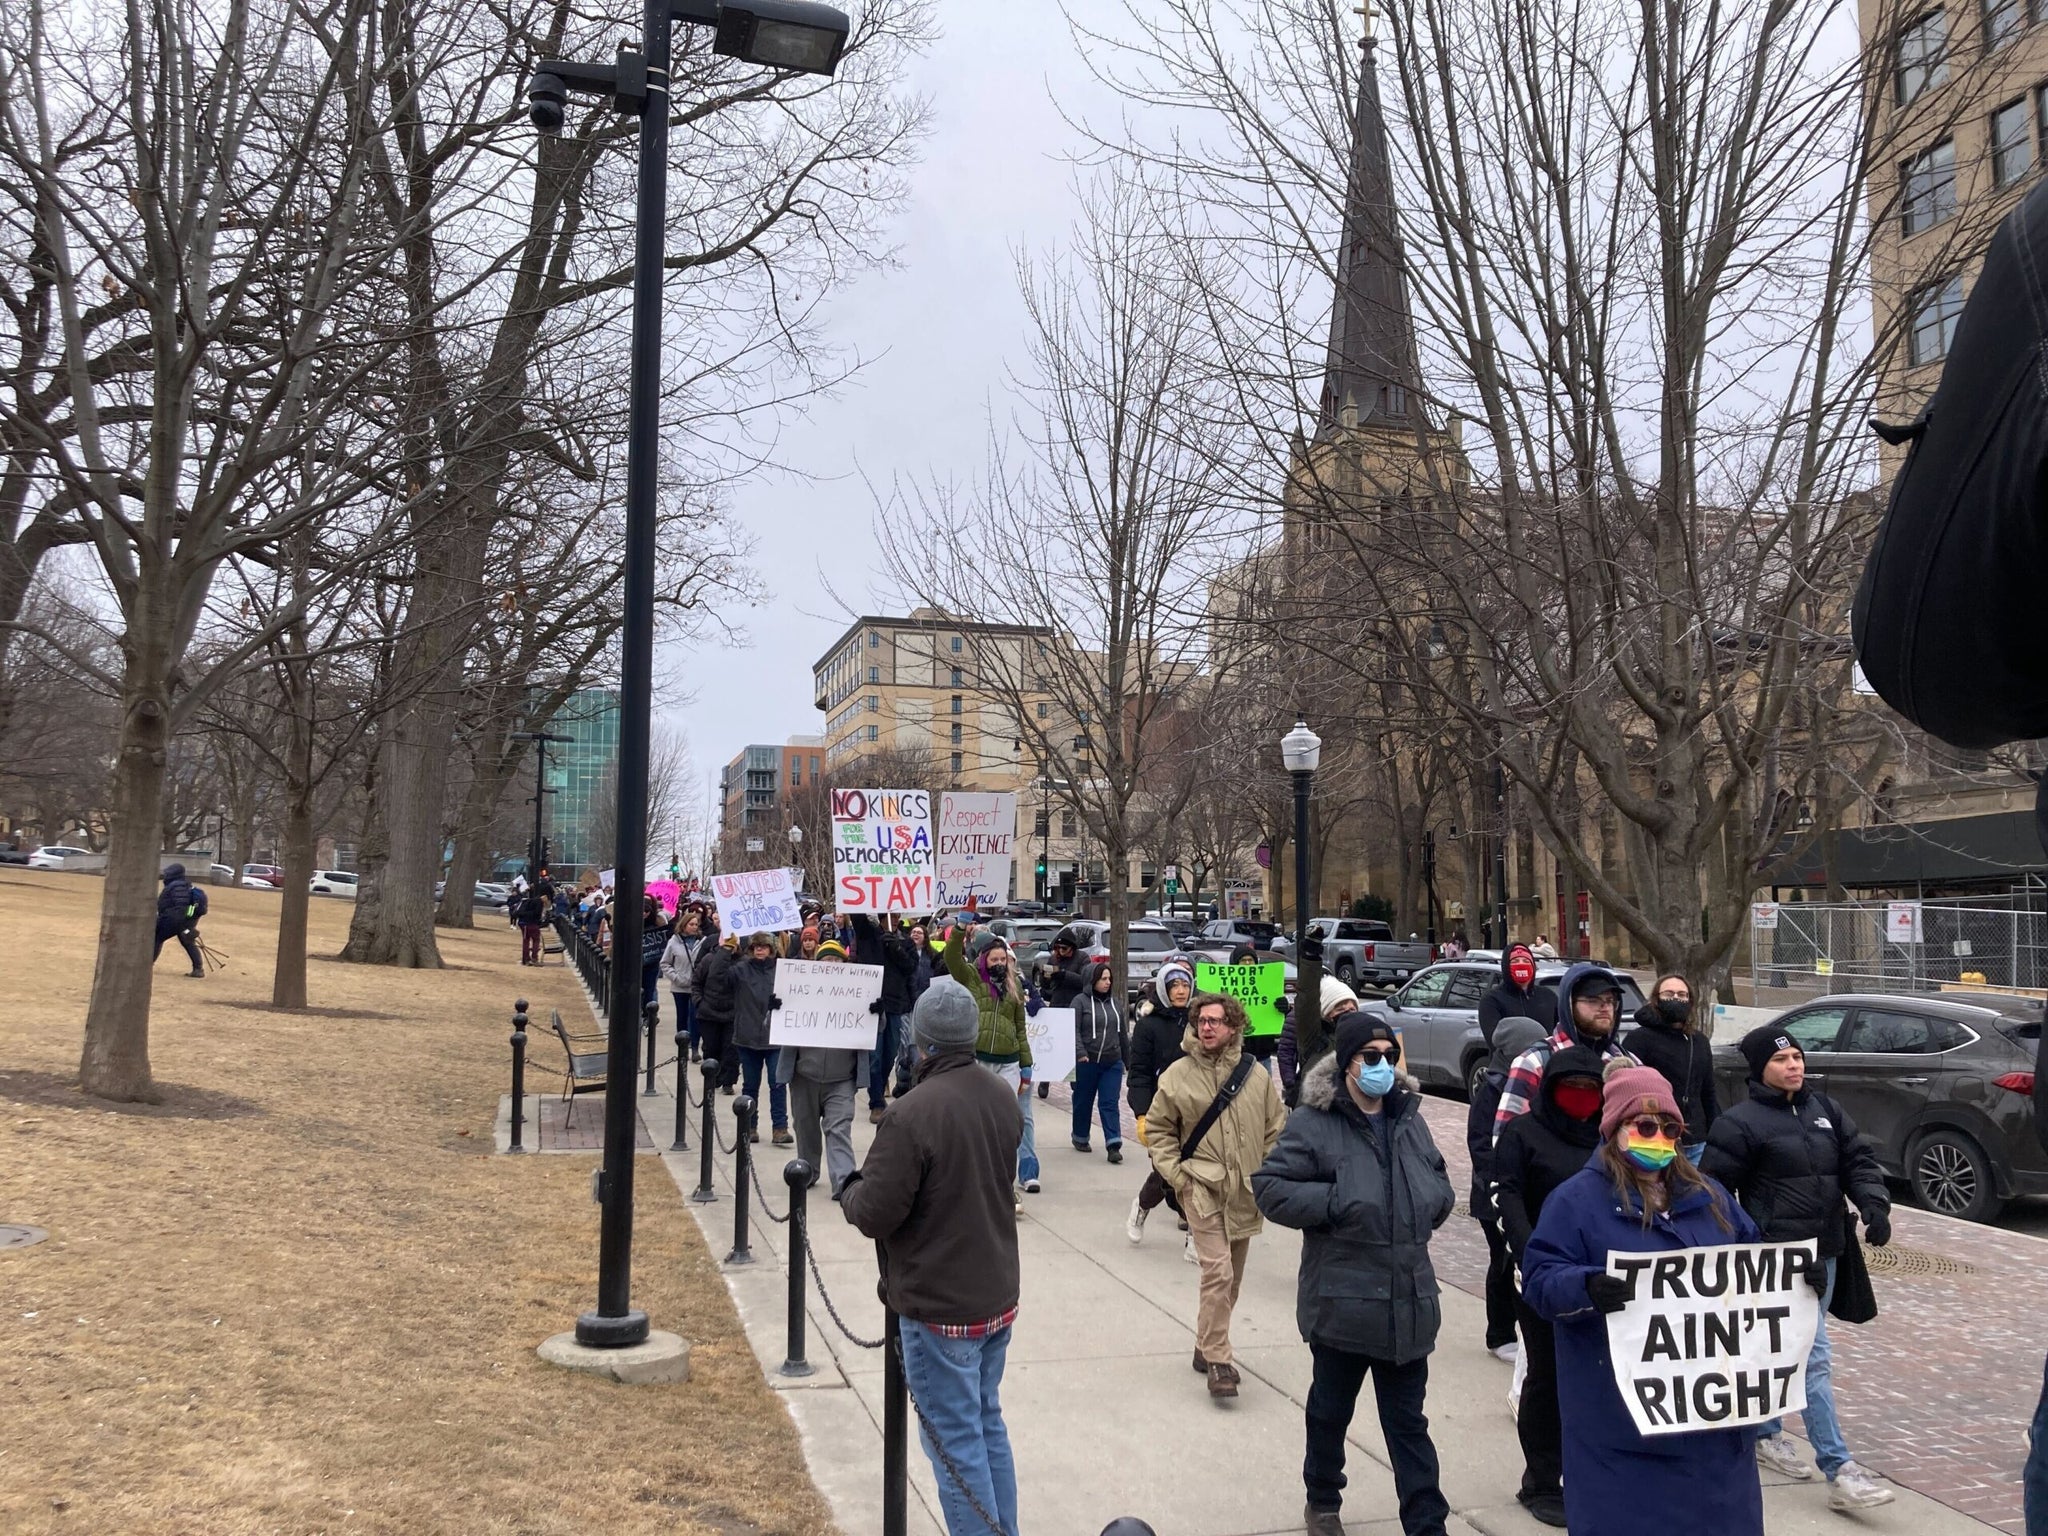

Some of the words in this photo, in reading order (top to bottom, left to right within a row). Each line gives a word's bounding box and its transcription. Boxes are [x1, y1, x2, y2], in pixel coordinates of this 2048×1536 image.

[832, 790, 867, 819] NO
[868, 794, 928, 820] KINGS
[943, 797, 1000, 833] Respect
[842, 824, 864, 833] FOR
[877, 825, 929, 849] USA
[841, 834, 867, 844] THE
[941, 834, 1011, 854] EXISTENCE
[834, 847, 932, 864] DEMOCRACY
[848, 864, 863, 875] IS
[870, 864, 899, 875] HERE
[904, 864, 920, 875] TO
[940, 861, 985, 883] Expect
[716, 871, 785, 898] UNITED
[841, 876, 931, 909] STAY!
[937, 881, 998, 906] Resistnce
[740, 893, 765, 911] WE
[730, 906, 783, 929] STAND
[642, 930, 669, 947] ESIST
[784, 963, 806, 974] THE
[811, 964, 845, 975] ENEMY
[849, 968, 880, 979] WITHIN
[1209, 966, 1265, 976] DEPORT
[1221, 976, 1256, 986] THIS
[789, 984, 811, 996] HAS
[816, 986, 824, 994] A
[784, 1010, 819, 1029] ELON
[825, 1011, 865, 1029] MUSK
[1614, 1247, 1813, 1301] TRUMP
[1641, 1306, 1790, 1362] AIN'T
[1633, 1363, 1799, 1426] RIGHT
